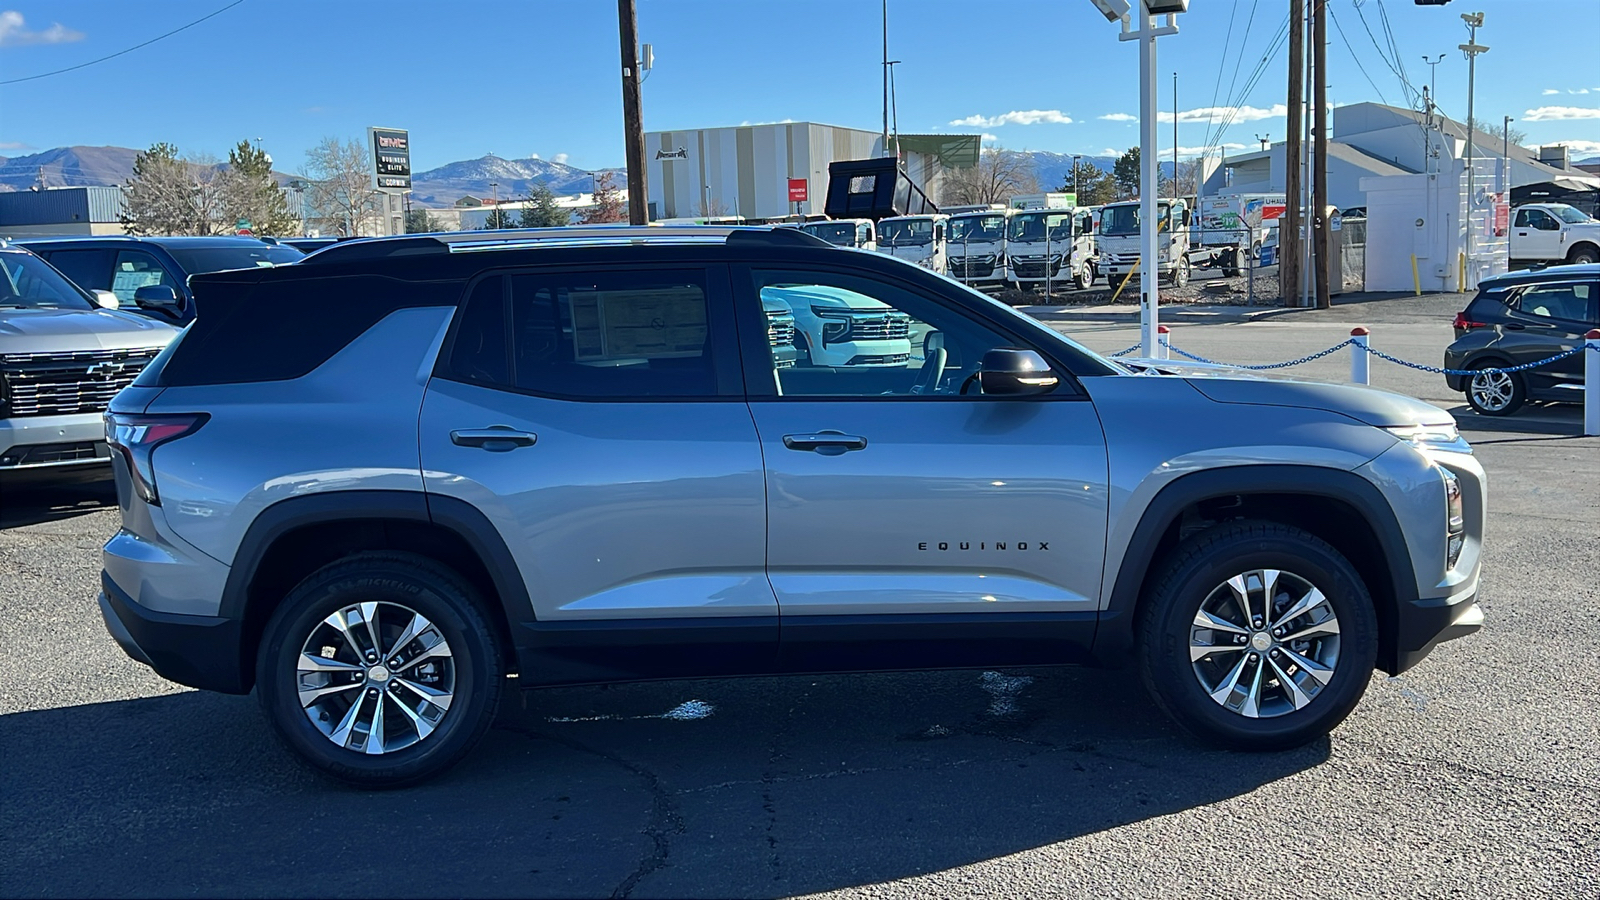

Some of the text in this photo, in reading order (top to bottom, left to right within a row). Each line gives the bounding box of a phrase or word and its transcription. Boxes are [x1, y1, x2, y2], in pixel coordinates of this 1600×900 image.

[379, 136, 406, 148] GMC
[918, 542, 1049, 551] EQUINOX
[357, 578, 420, 594] MICHELIN
